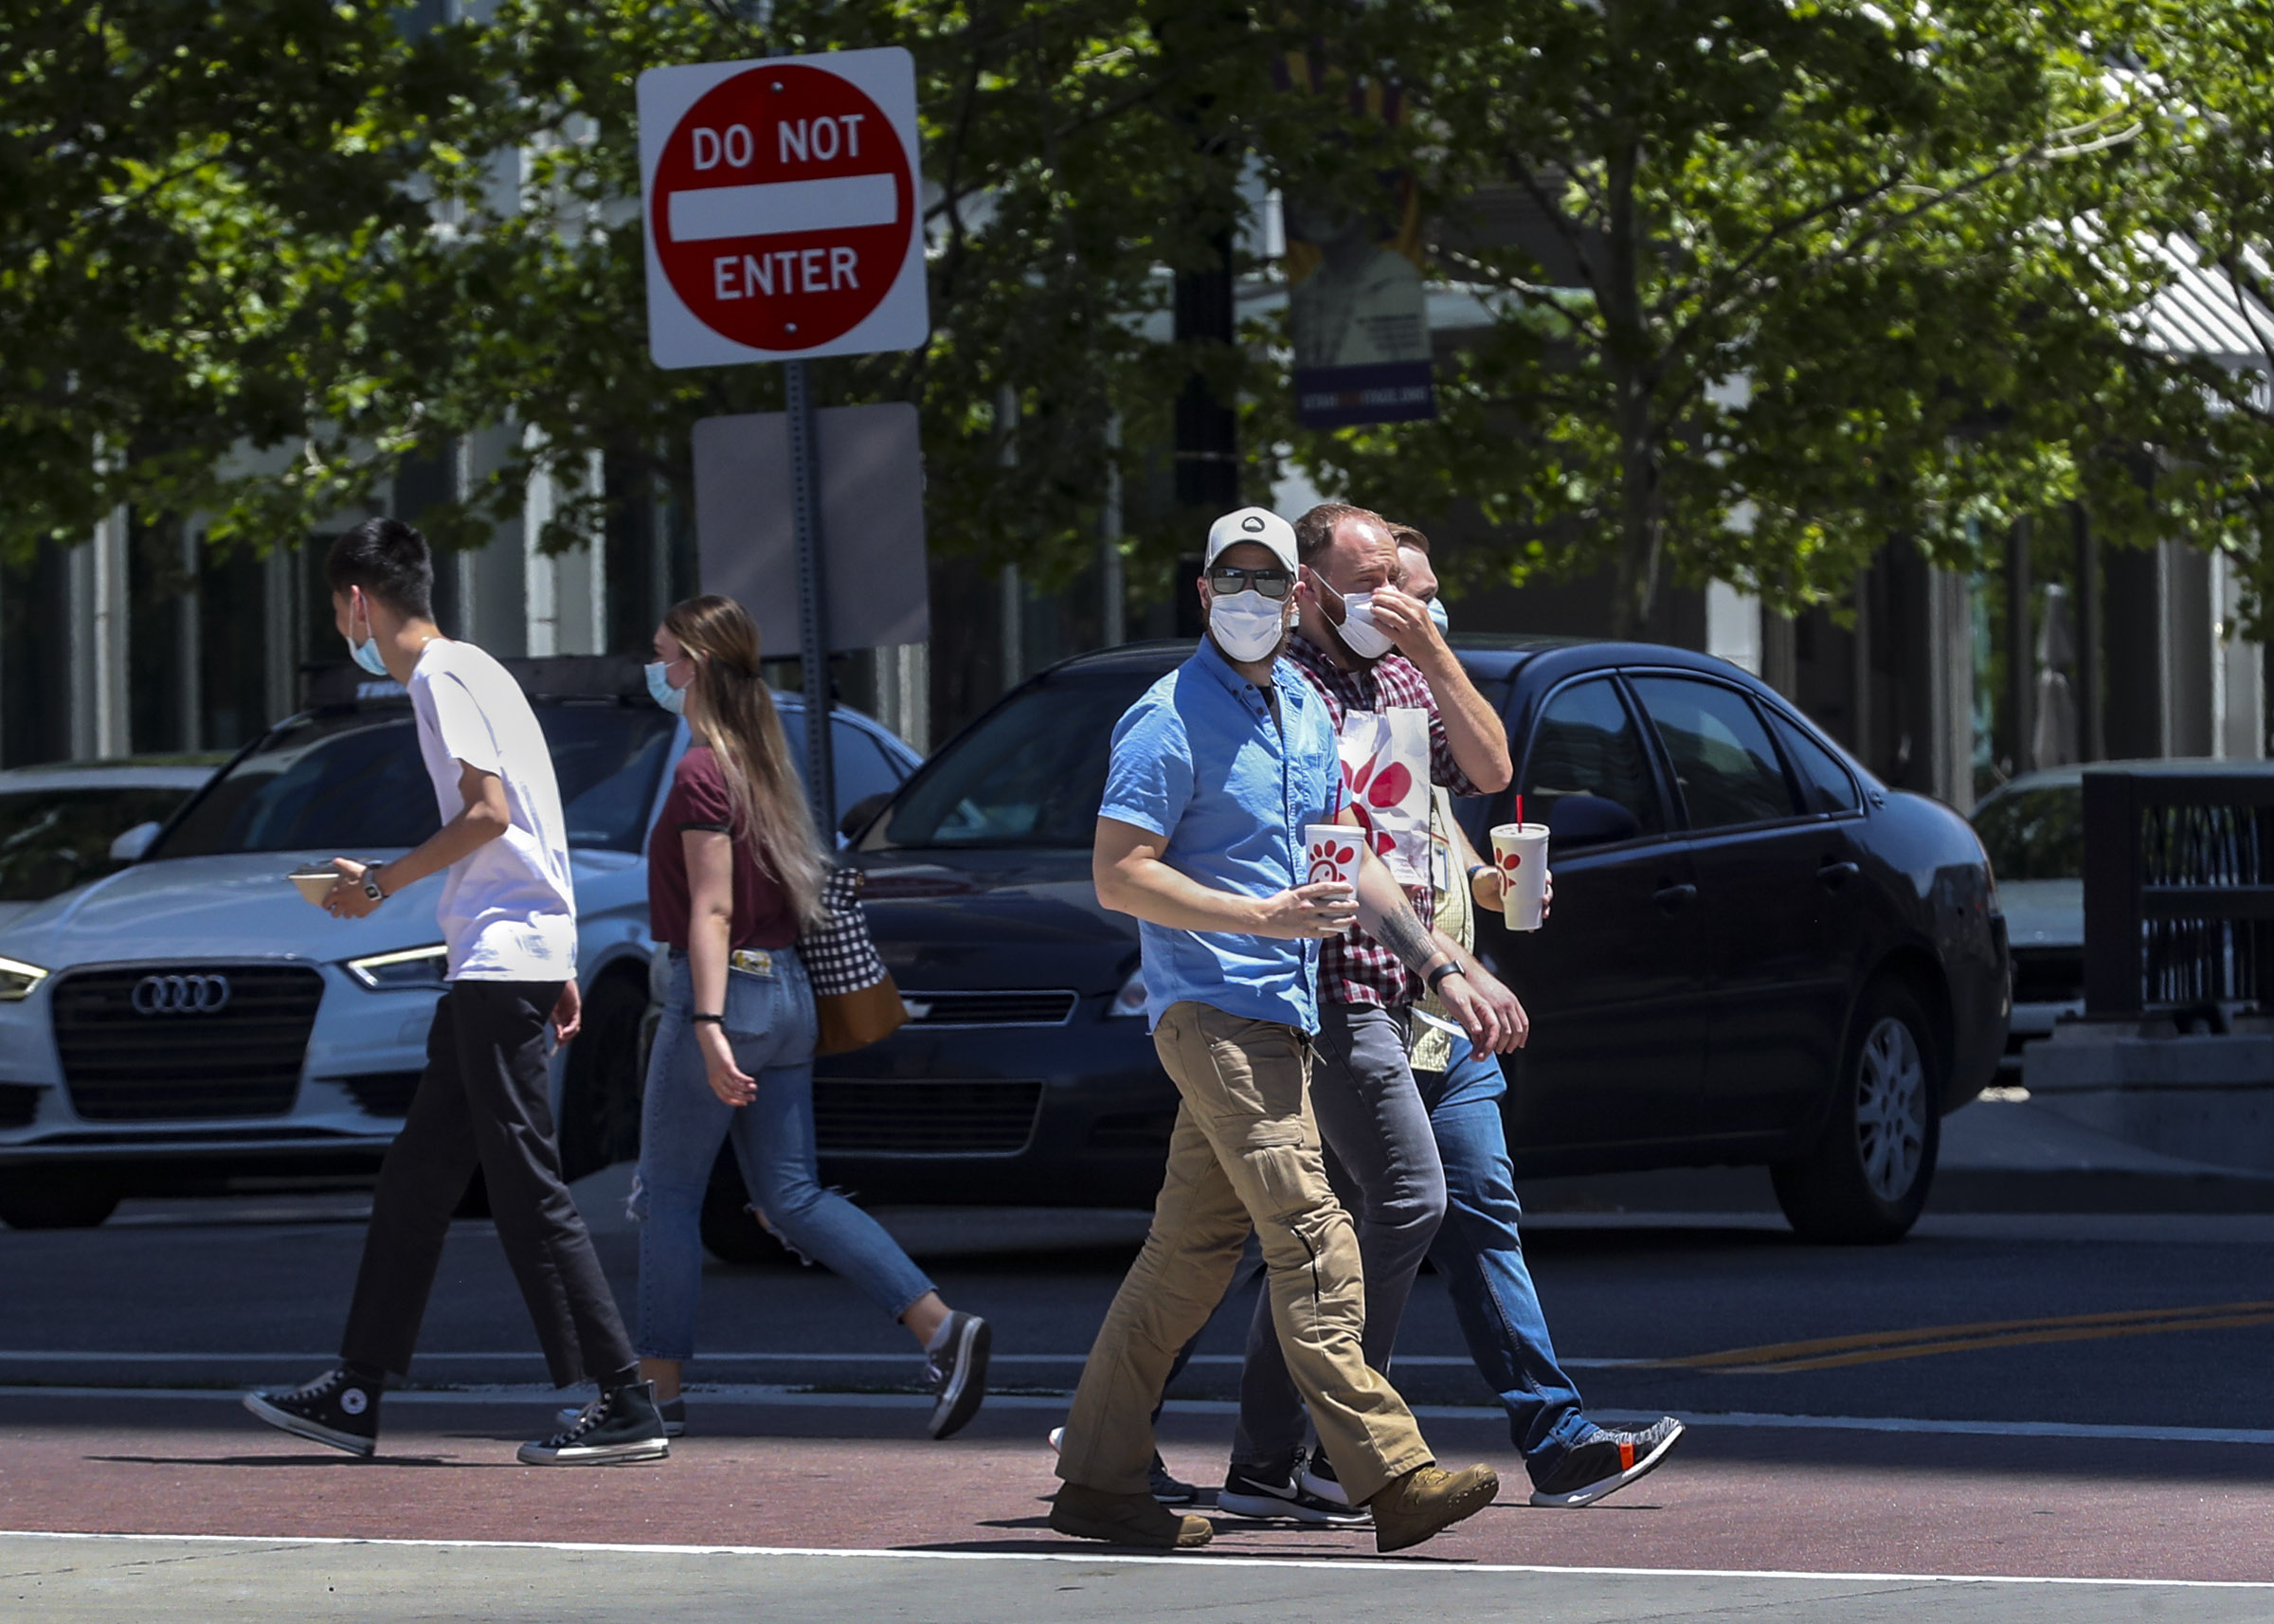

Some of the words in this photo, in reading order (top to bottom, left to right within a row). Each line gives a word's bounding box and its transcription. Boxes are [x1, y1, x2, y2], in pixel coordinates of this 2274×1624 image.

[692, 123, 754, 171] DO
[778, 113, 865, 164] NOT
[713, 246, 859, 300] ENTER
